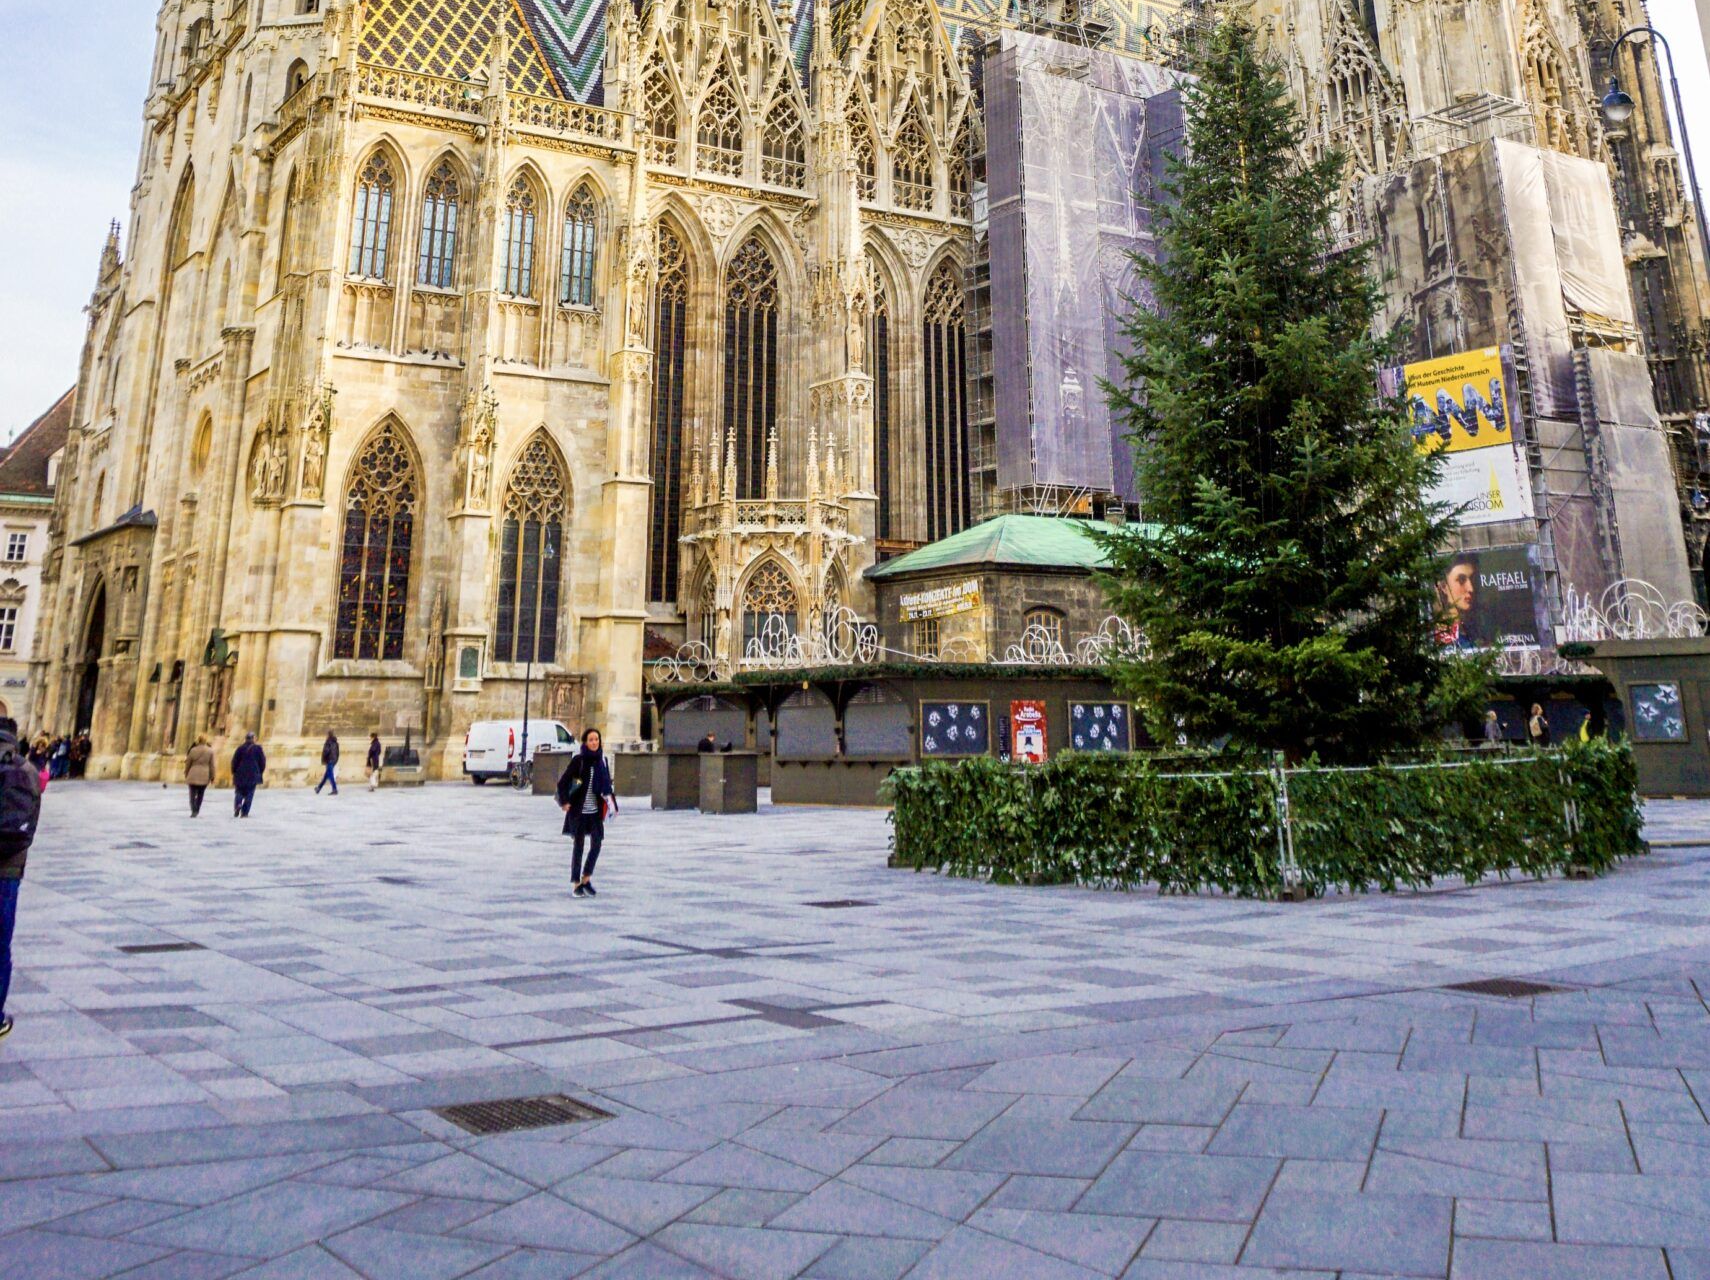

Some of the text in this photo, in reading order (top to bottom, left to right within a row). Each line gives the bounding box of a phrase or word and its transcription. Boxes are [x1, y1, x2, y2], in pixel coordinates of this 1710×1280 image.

[1433, 365, 1465, 376] Geschichte
[1417, 378, 1440, 387] Museum
[1441, 368, 1490, 383] Niederösterreich
[1476, 489, 1501, 500] UNSER
[1480, 571, 1527, 587] RAFFAEL
